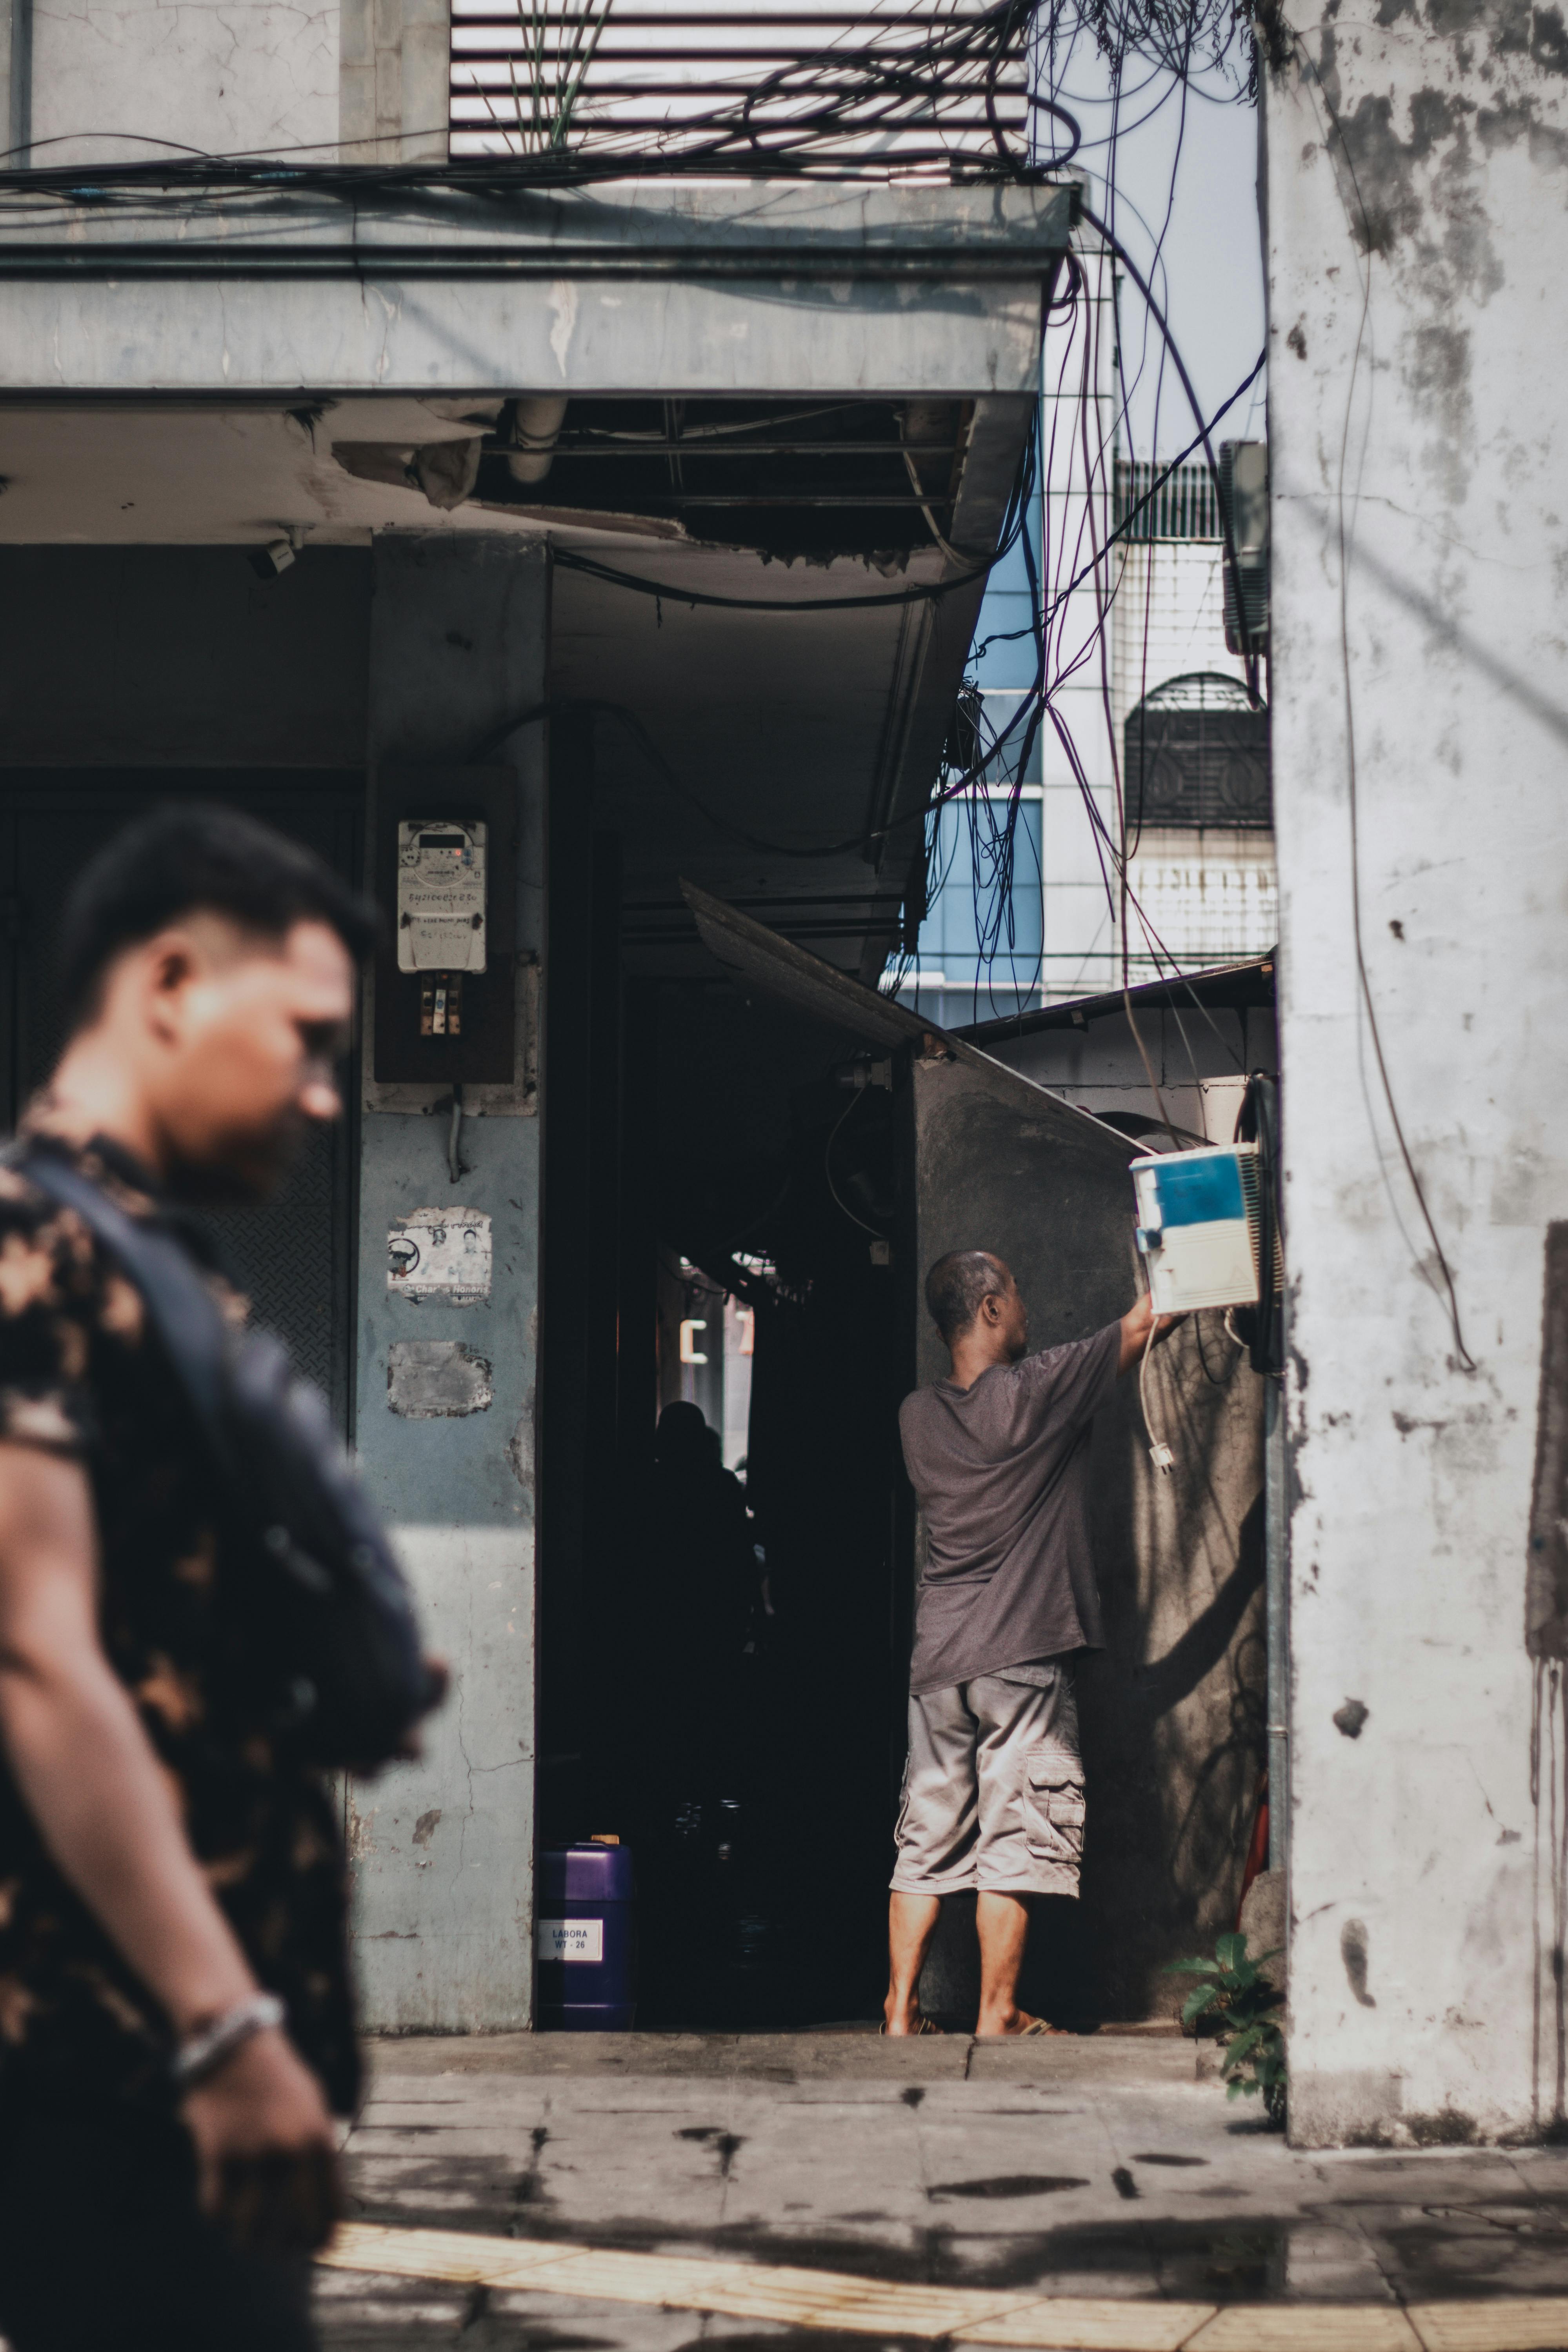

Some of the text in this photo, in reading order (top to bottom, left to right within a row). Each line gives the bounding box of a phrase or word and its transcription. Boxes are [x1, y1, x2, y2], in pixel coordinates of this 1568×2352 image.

[415, 1284, 488, 1294] Chars Honoris
[553, 1930, 588, 1938] LABORA
